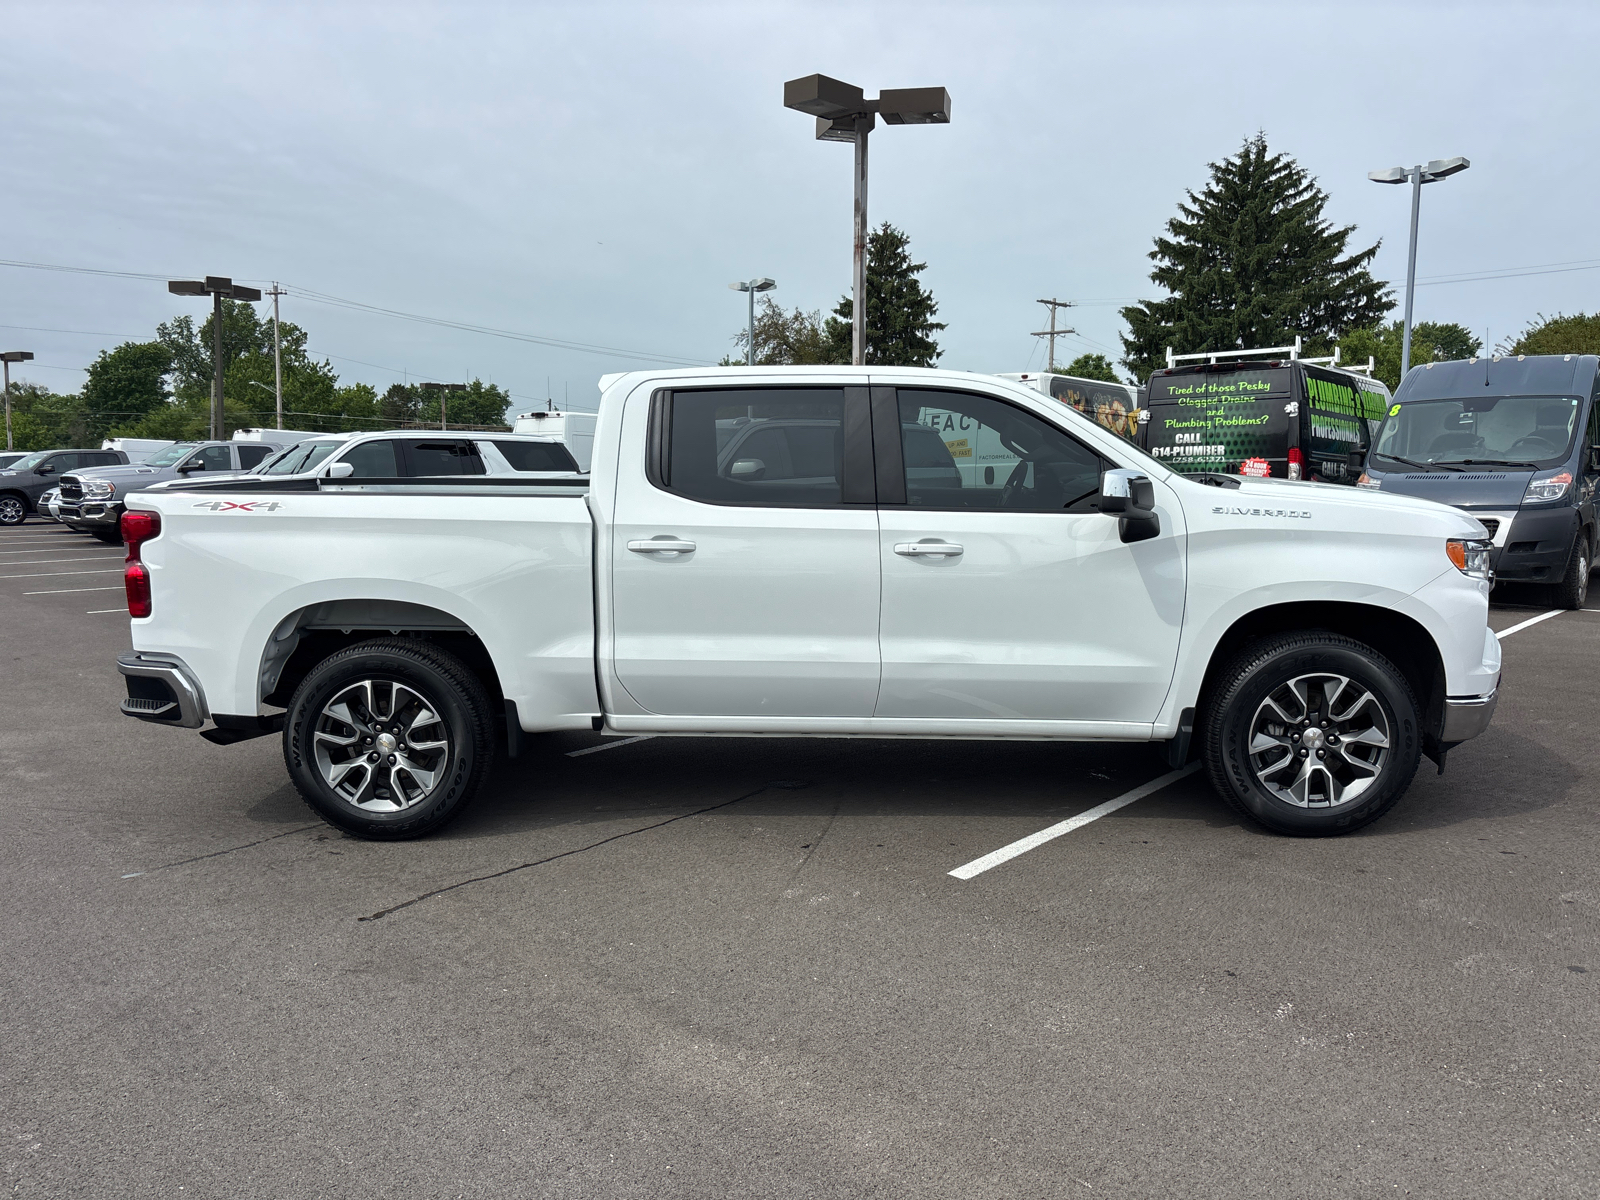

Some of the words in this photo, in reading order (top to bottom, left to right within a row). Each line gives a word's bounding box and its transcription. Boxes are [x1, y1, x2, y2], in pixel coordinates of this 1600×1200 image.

[1167, 385, 1193, 395] Tired
[1196, 383, 1207, 393] of
[1208, 383, 1236, 392] those
[1237, 380, 1270, 392] Pesky
[1178, 396, 1218, 408] Clogged
[1221, 395, 1256, 404] Drains
[1307, 377, 1356, 417] PLUMBING
[1355, 393, 1363, 418] &
[1207, 407, 1225, 416] and
[1164, 417, 1211, 429] Plumbing
[1214, 415, 1269, 426] Problems?
[1311, 414, 1360, 443] PROFESSIONALS
[1175, 433, 1201, 444] CALL
[1152, 445, 1225, 457] 614-PLUMBER
[1245, 460, 1254, 468] 24
[1322, 461, 1338, 477] CALL
[1212, 507, 1312, 518] SILVERADO
